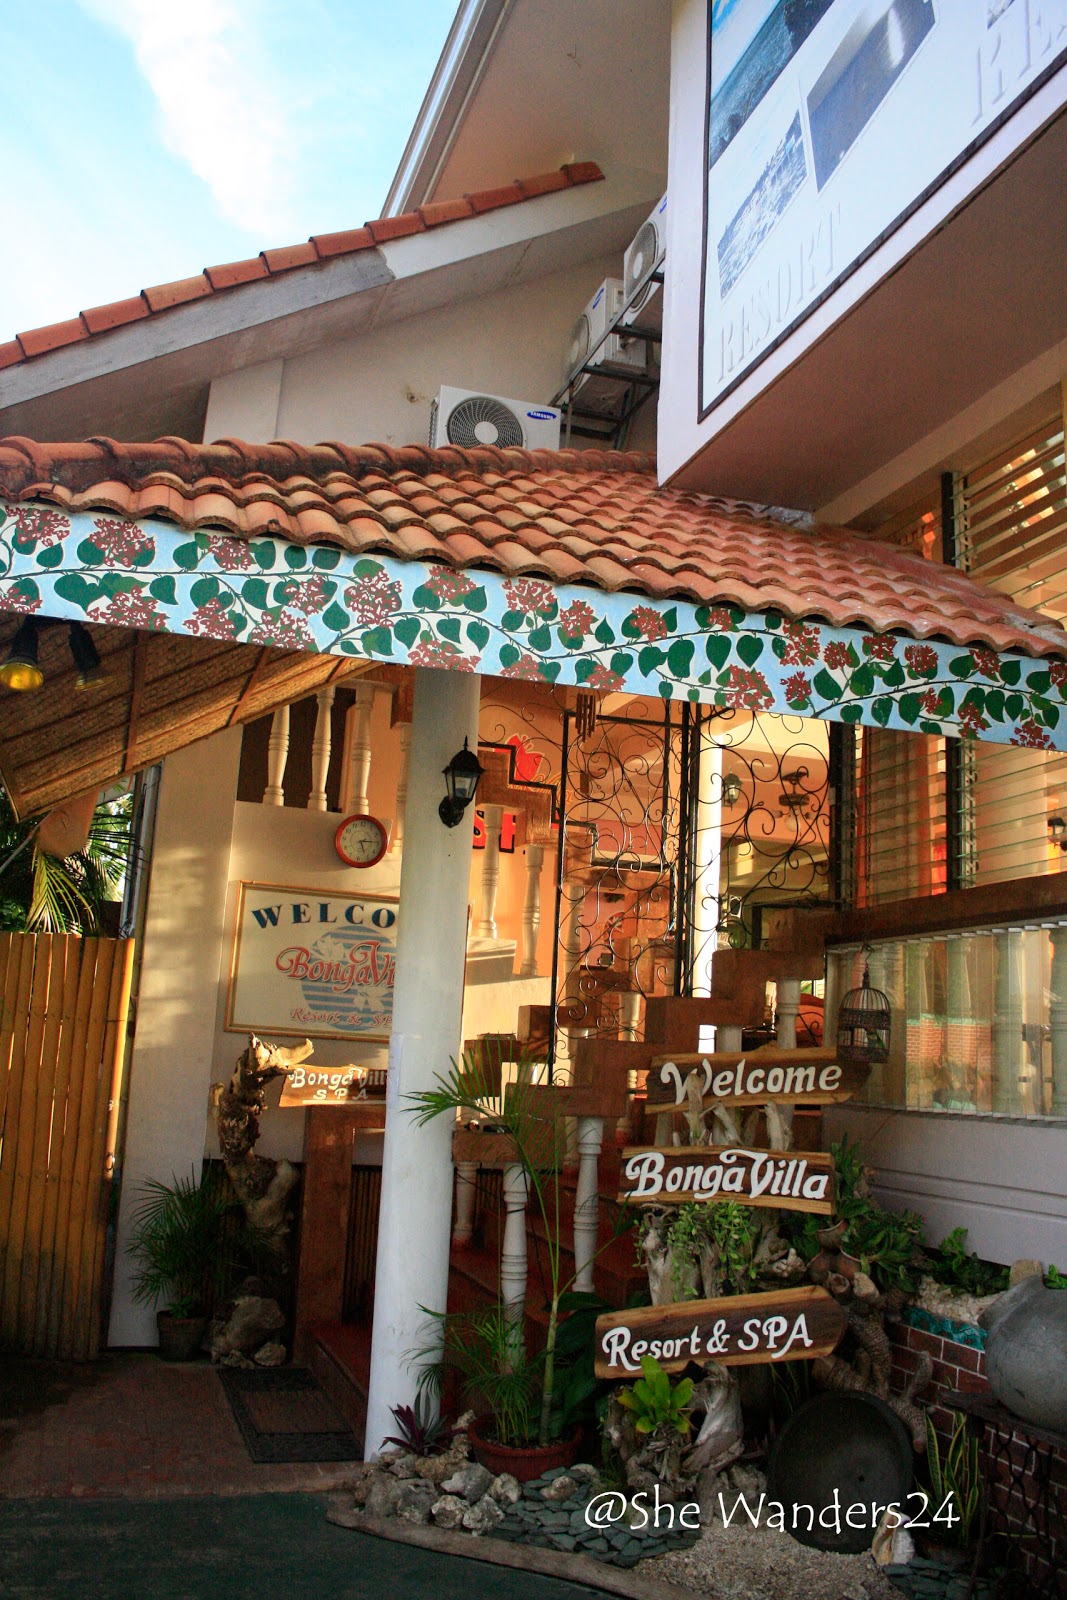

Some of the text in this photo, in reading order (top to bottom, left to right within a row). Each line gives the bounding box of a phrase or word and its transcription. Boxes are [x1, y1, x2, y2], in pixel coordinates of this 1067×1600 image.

[252, 901, 396, 929] WELCO
[275, 940, 396, 992] BongaVi
[290, 1007, 392, 1027] Resort & SP
[289, 1065, 387, 1088] BongaVill
[660, 1058, 842, 1105] Welcome
[313, 1088, 369, 1100] SPA
[602, 1313, 814, 1371] Resort & SPA
